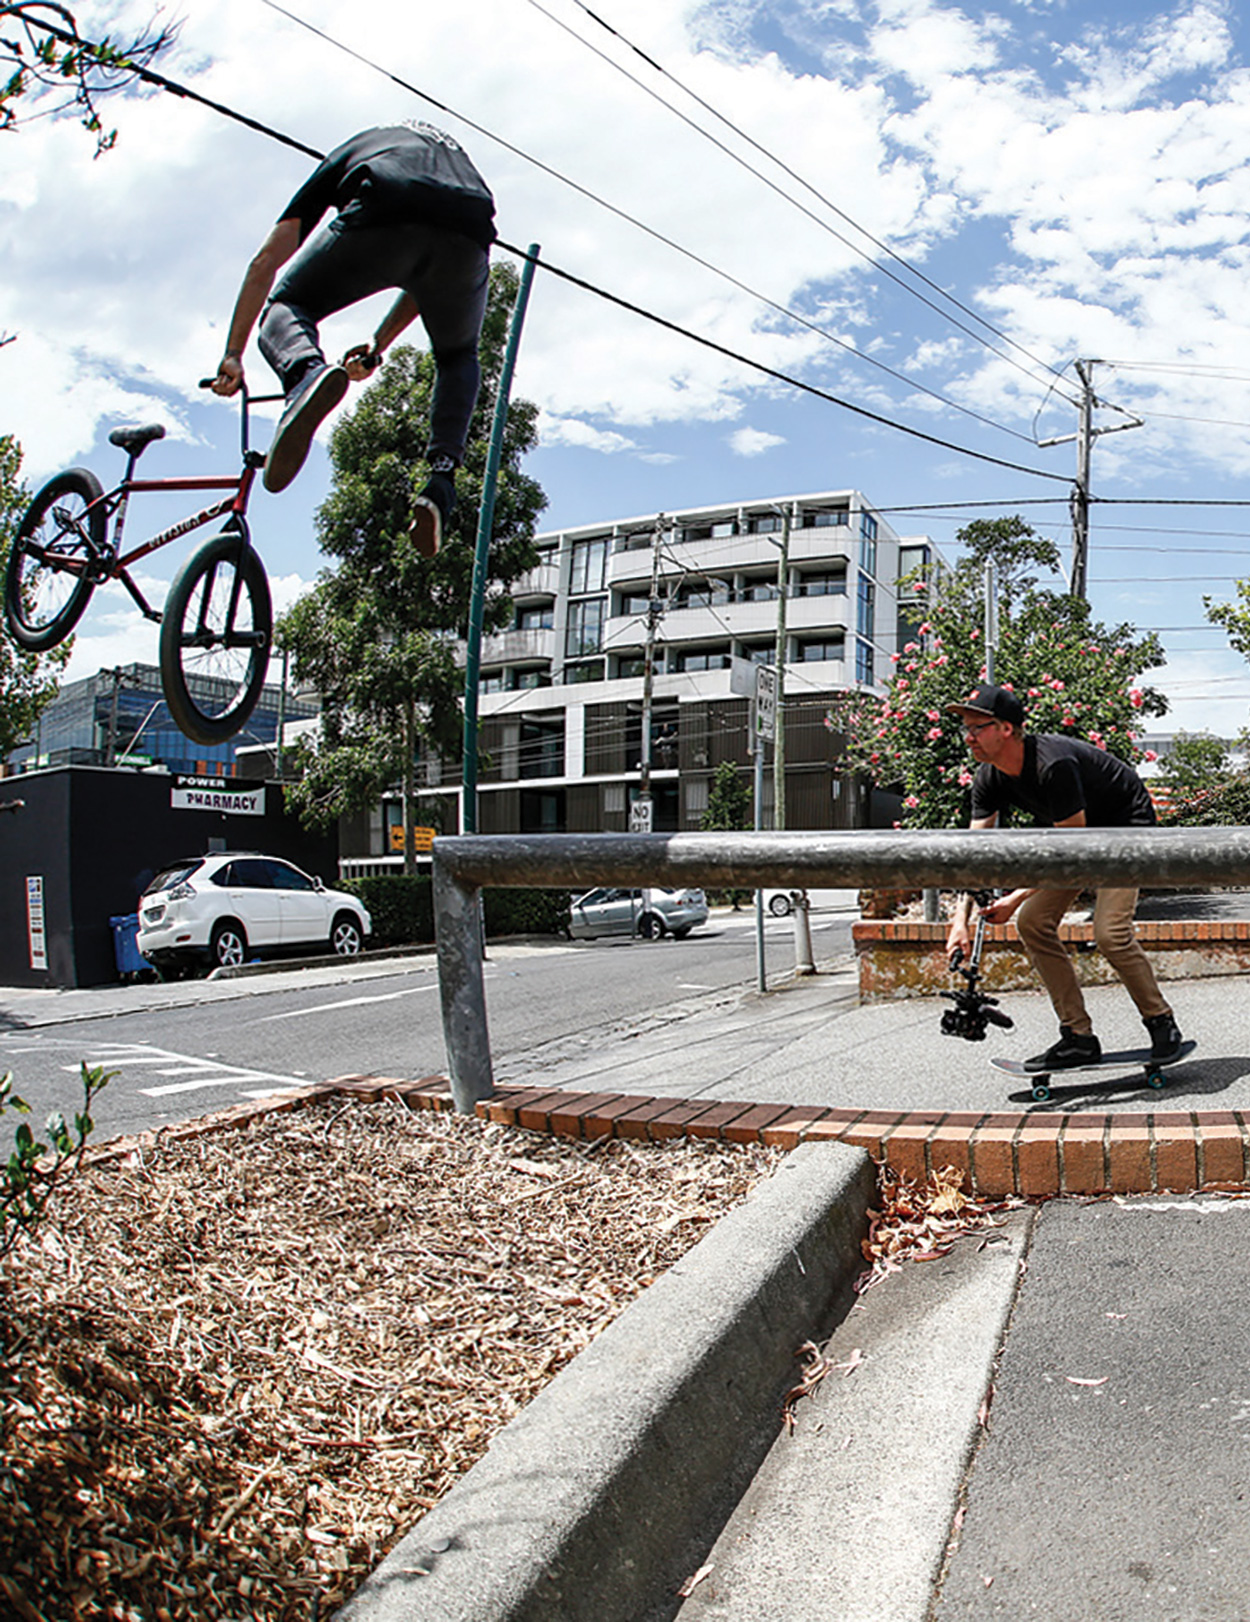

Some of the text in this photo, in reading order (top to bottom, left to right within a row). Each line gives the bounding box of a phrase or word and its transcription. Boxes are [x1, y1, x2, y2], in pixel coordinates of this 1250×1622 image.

[759, 673, 773, 694] ONE
[758, 696, 773, 713] WAY
[177, 776, 226, 787] POWER
[186, 793, 257, 810] PHARMACY
[633, 805, 649, 820] NO
